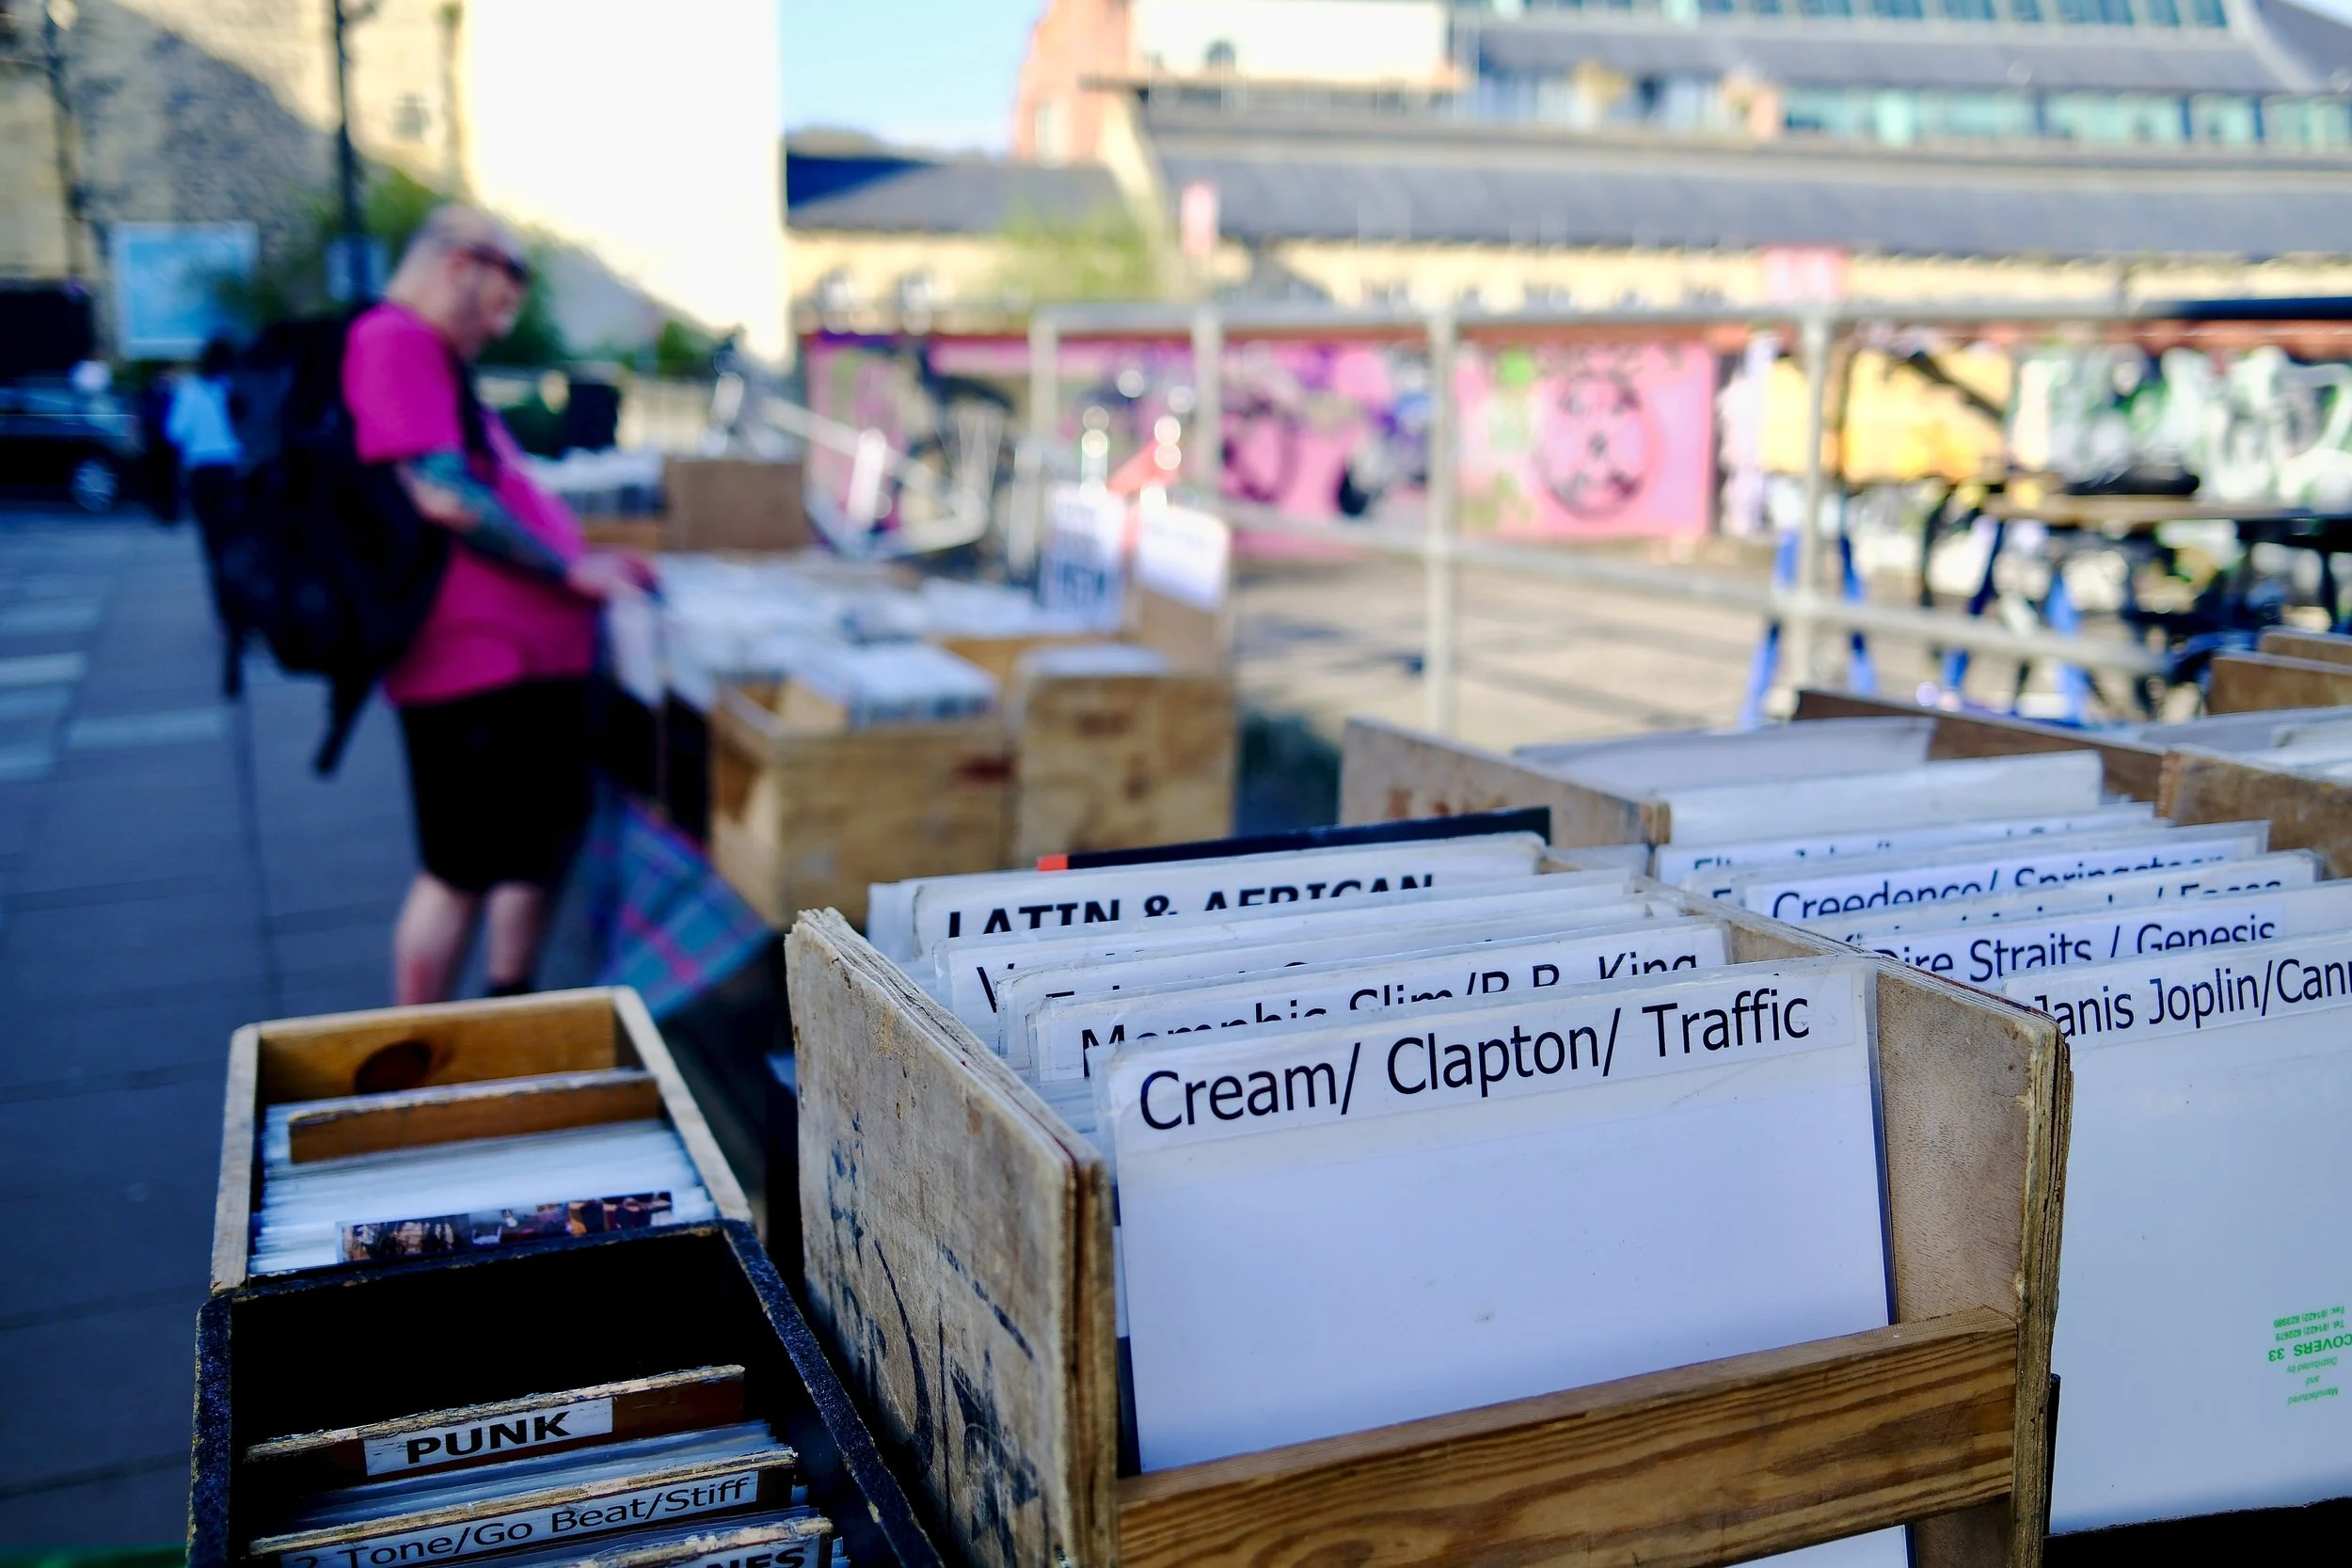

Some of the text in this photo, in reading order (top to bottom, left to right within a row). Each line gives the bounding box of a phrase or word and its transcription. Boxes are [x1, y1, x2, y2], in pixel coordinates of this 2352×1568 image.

[948, 899, 1120, 938] LATIN
[1143, 895, 1178, 917] &
[1970, 932, 2091, 982] Straits
[2137, 914, 2275, 954] Genesis
[2149, 958, 2352, 1030] Joplin/Can
[1140, 1042, 1361, 1131] Cream/
[1387, 1007, 1621, 1097] Clapton/
[1642, 988, 1810, 1057] Traffic
[2268, 1333, 2352, 1362] COVERS 33
[406, 1411, 571, 1465] PUNK
[337, 1522, 533, 1568] Tone/Go
[551, 1476, 750, 1533] Beat/Stiff
